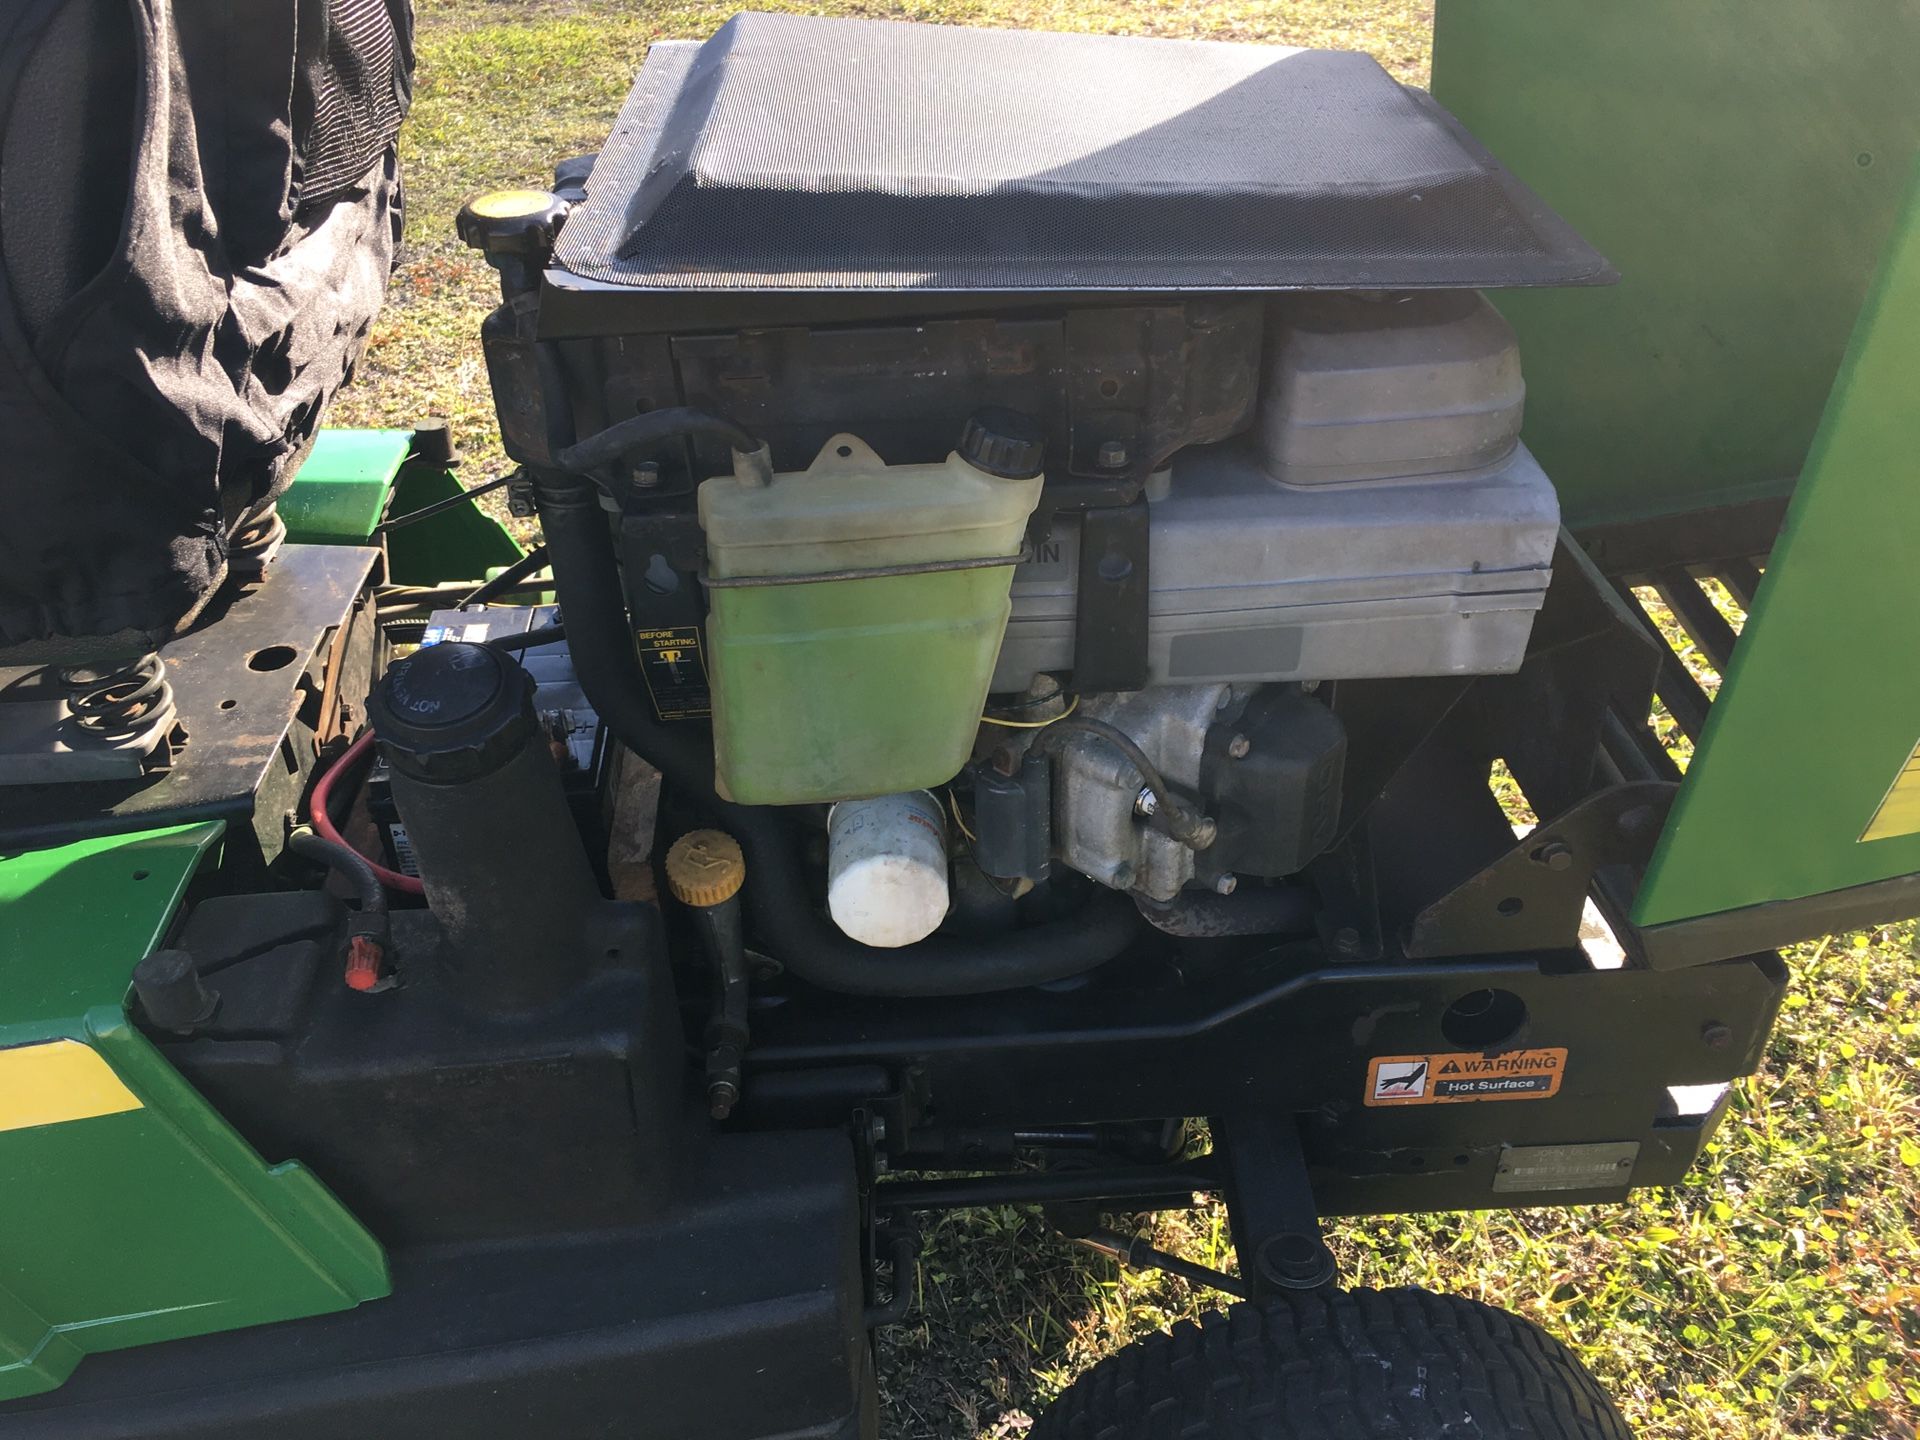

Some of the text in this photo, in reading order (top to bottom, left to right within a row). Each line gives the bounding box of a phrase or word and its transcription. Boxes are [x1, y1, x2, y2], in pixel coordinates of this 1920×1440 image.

[640, 631, 673, 639] BEFORE
[653, 638, 696, 647] STARTING
[409, 699, 441, 713] NOT
[1464, 1056, 1558, 1073] WARNING
[1448, 1079, 1535, 1092] Hot Surface
